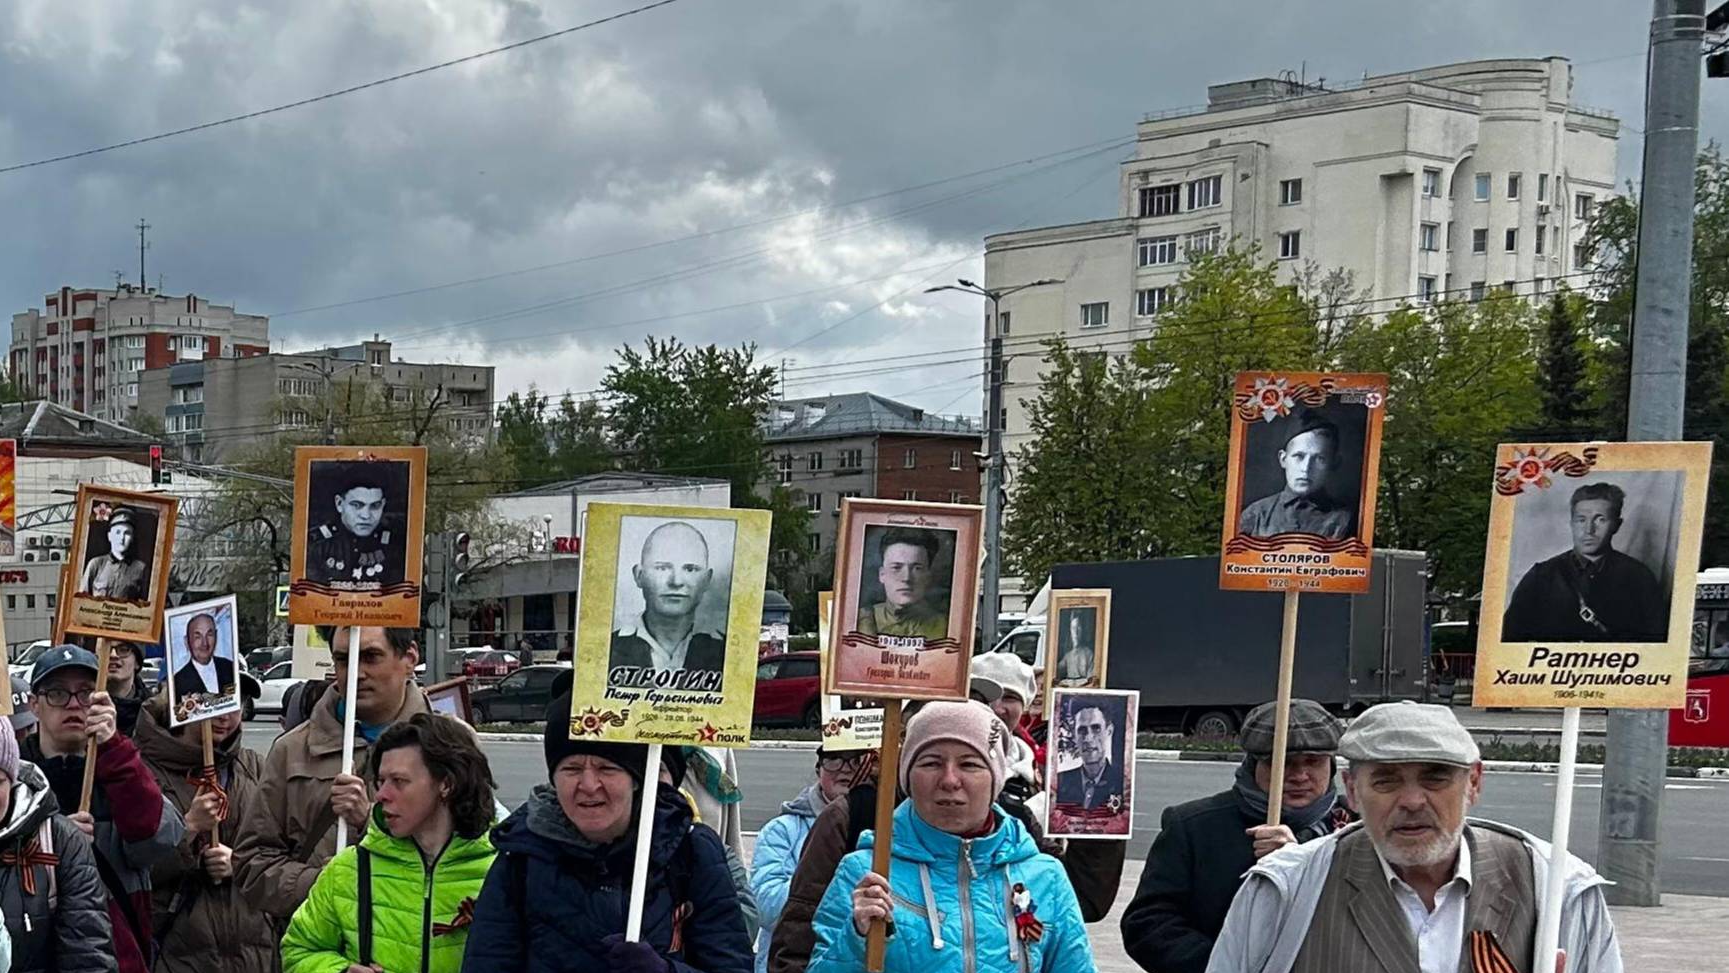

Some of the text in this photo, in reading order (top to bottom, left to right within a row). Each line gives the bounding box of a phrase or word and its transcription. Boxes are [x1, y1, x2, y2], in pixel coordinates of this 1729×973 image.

[1262, 553, 1330, 563] СТОЛЯРОВ
[1226, 564, 1366, 576] Константин Евграфович
[332, 598, 383, 608] Гаврилов
[1528, 647, 1640, 672] Ратнер
[609, 667, 722, 690] СТРОГИН
[1494, 670, 1672, 688] Хаим Шулимович
[605, 688, 640, 705] Петр
